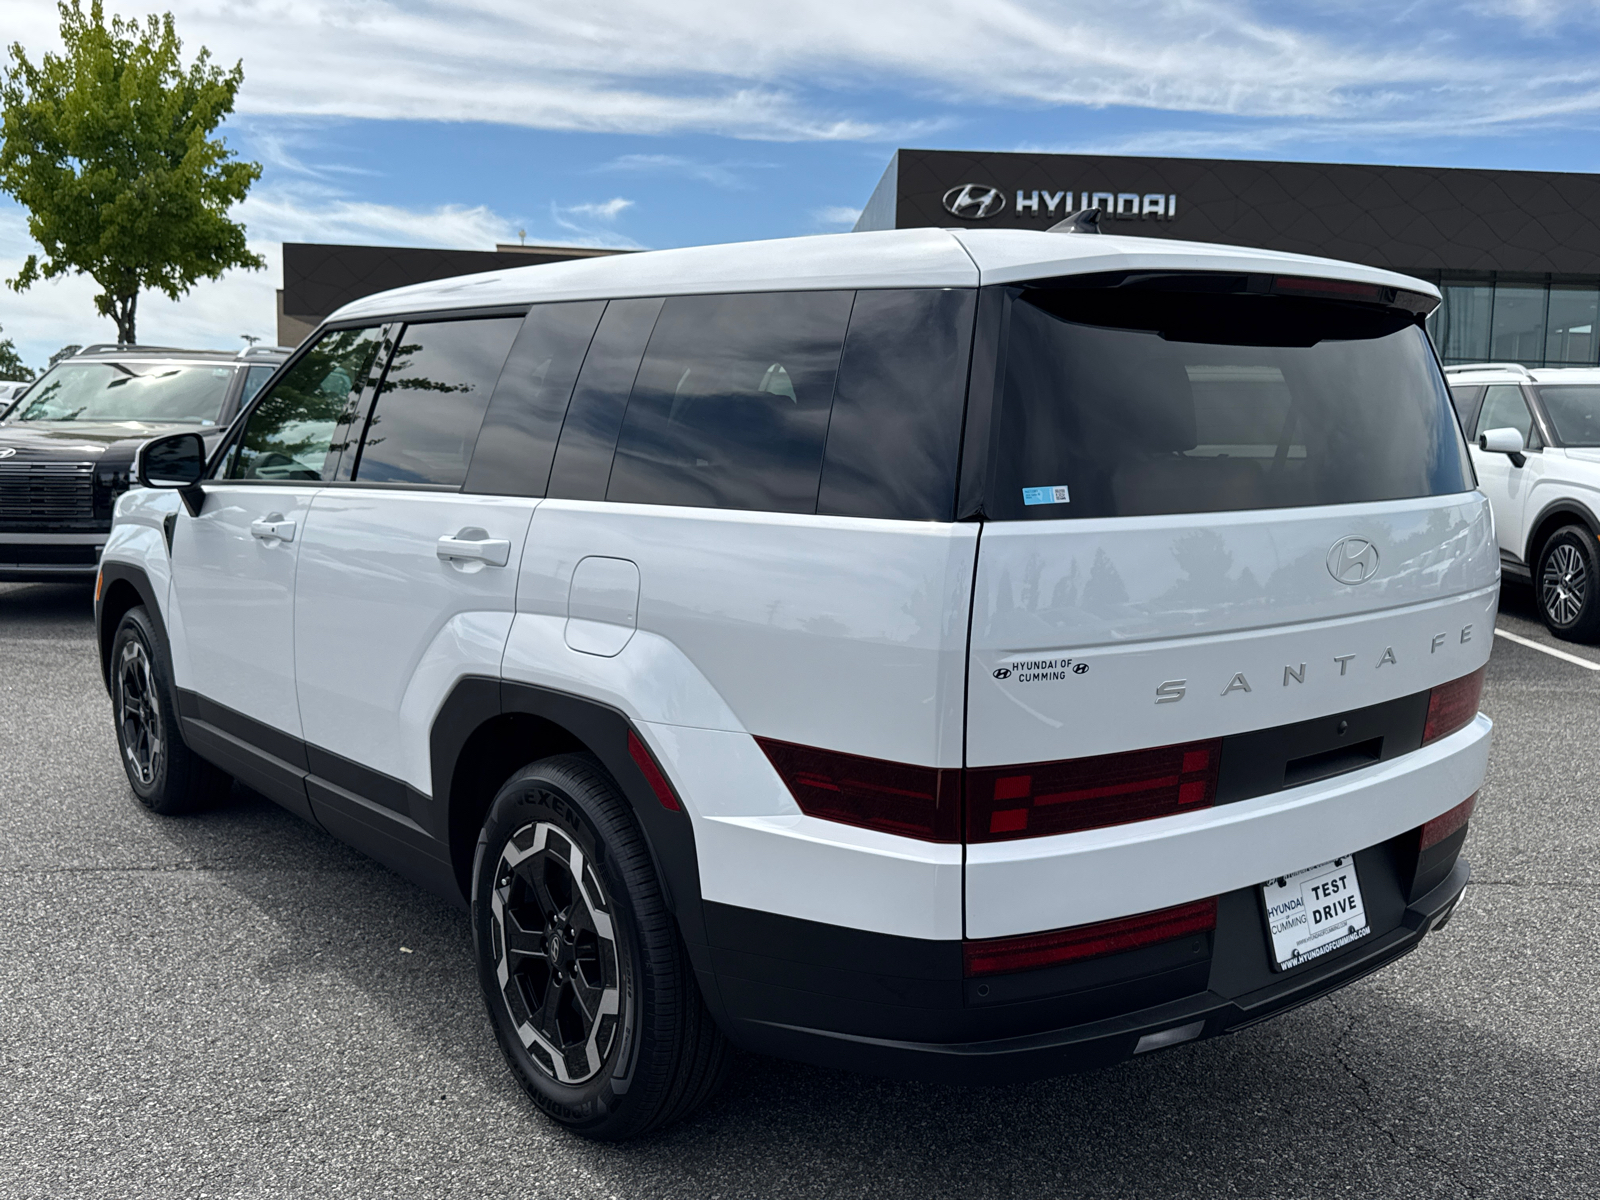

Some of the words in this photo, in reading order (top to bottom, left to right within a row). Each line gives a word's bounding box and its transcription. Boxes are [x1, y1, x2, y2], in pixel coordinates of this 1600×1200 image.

[1016, 189, 1176, 220] HYUNDAI
[1012, 660, 1057, 671] HYUNDAI
[1060, 659, 1073, 668] OF
[1018, 671, 1066, 683] CUMMING
[1154, 645, 1397, 704] SANTA
[1431, 623, 1473, 654] FE
[514, 788, 581, 832] NEXEN
[1311, 875, 1347, 901] TEST
[1268, 897, 1304, 918] HYUNDAI
[1312, 895, 1357, 925] DRIVE
[1271, 914, 1307, 935] CUMMING
[1280, 926, 1371, 971] WWW.HYUNDAIOFCUMMING.COM
